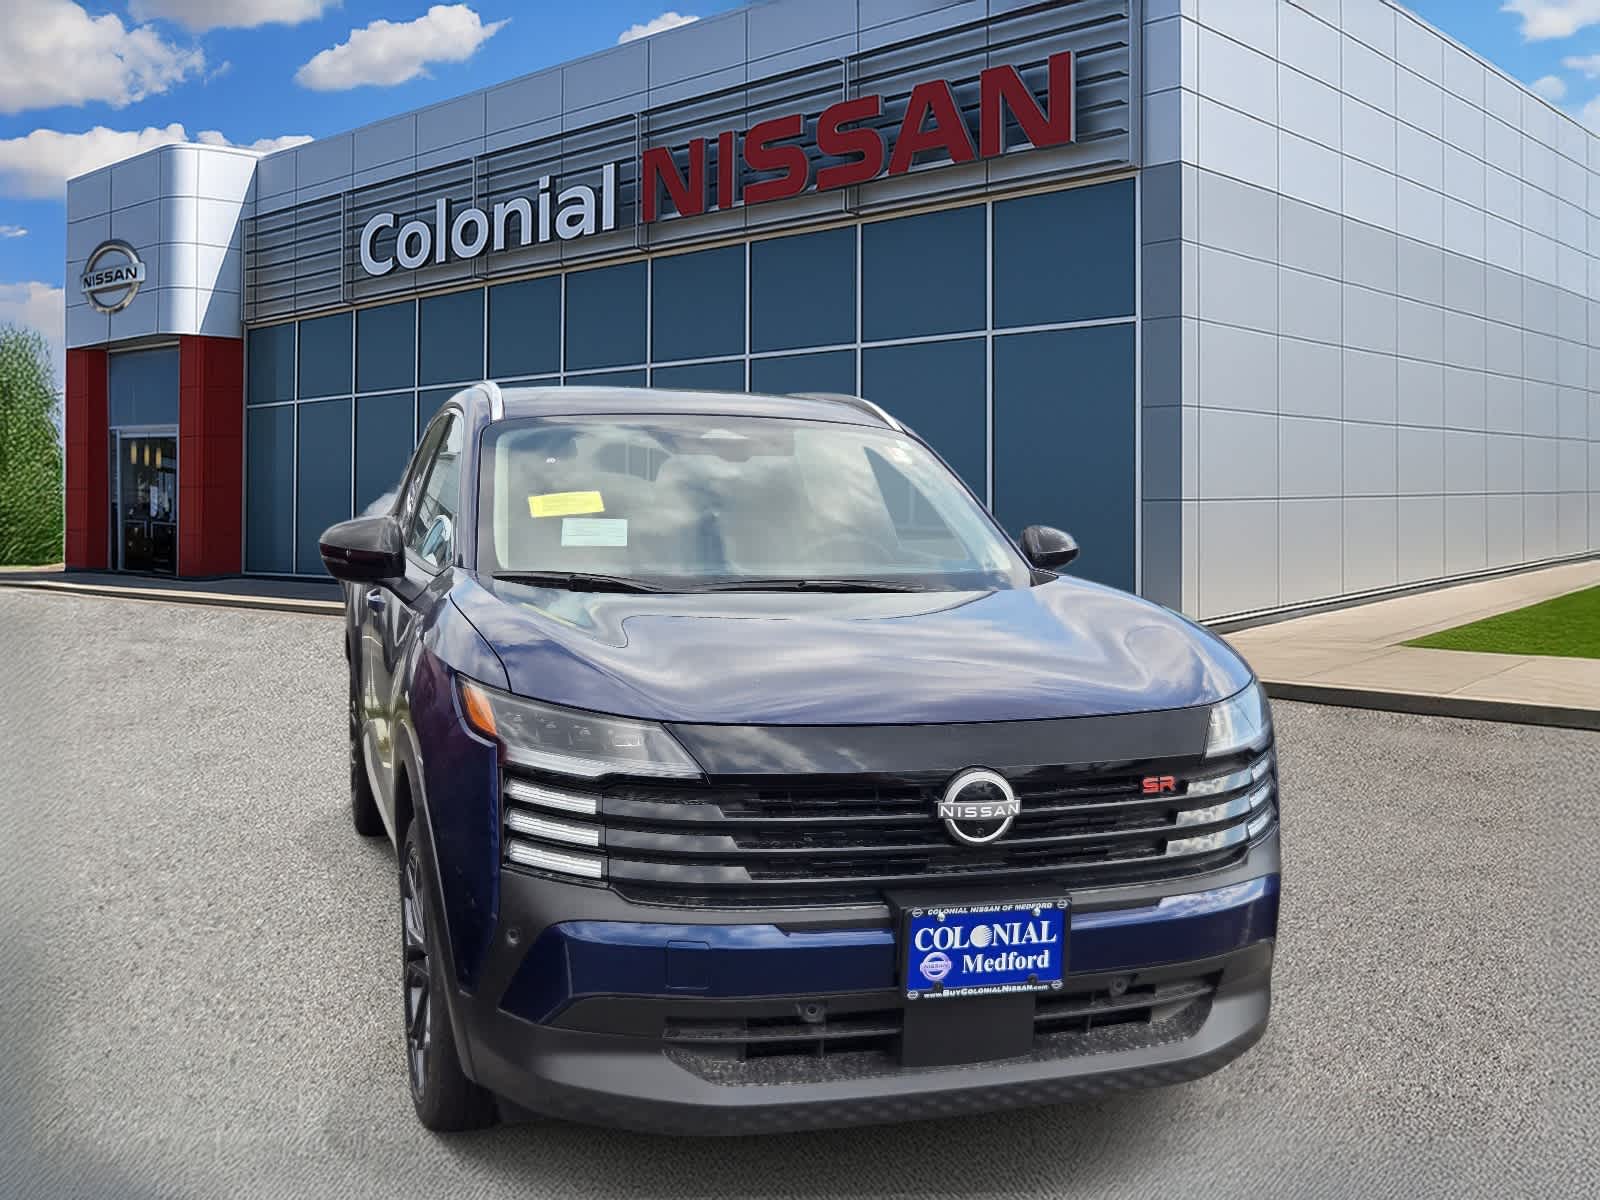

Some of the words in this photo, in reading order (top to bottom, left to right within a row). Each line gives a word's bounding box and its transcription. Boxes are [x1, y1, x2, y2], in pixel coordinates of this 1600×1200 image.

[359, 162, 617, 276] Colonial
[641, 50, 1077, 223] NISSAN
[83, 266, 137, 289] NISSAN
[1142, 775, 1176, 793] SR
[940, 802, 1019, 817] NISSAN
[927, 907, 968, 916] COLONIAL
[970, 905, 1000, 913] NISSAN
[1015, 902, 1053, 911] MEDFORD
[962, 949, 1049, 974] Medford
